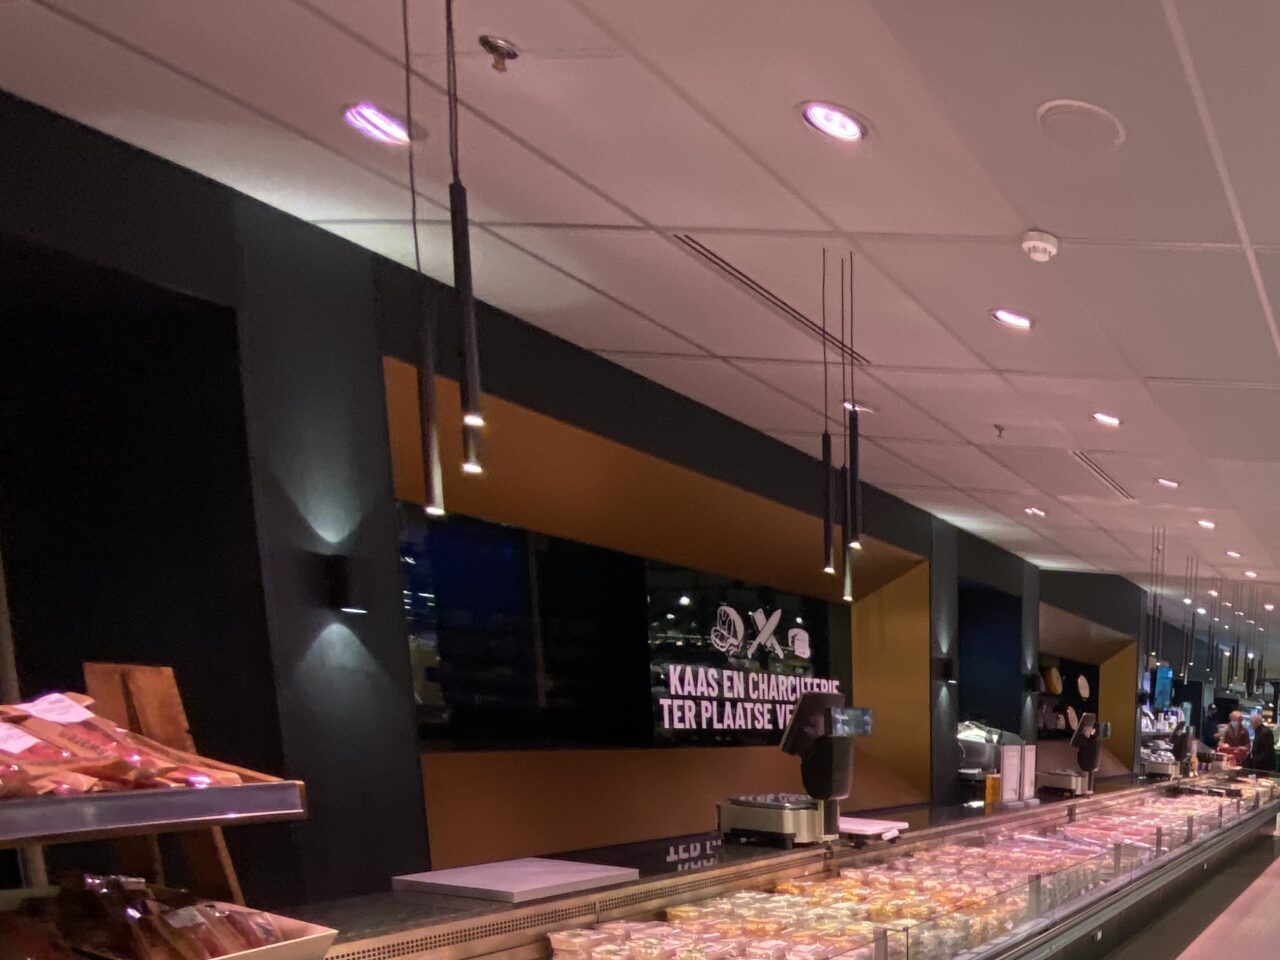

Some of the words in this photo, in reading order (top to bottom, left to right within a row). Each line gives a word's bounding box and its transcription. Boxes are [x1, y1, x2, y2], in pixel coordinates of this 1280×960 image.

[669, 664, 719, 698] KAAS
[722, 669, 745, 699] EN
[659, 698, 697, 729] TER
[700, 700, 773, 730] PLAATSE
